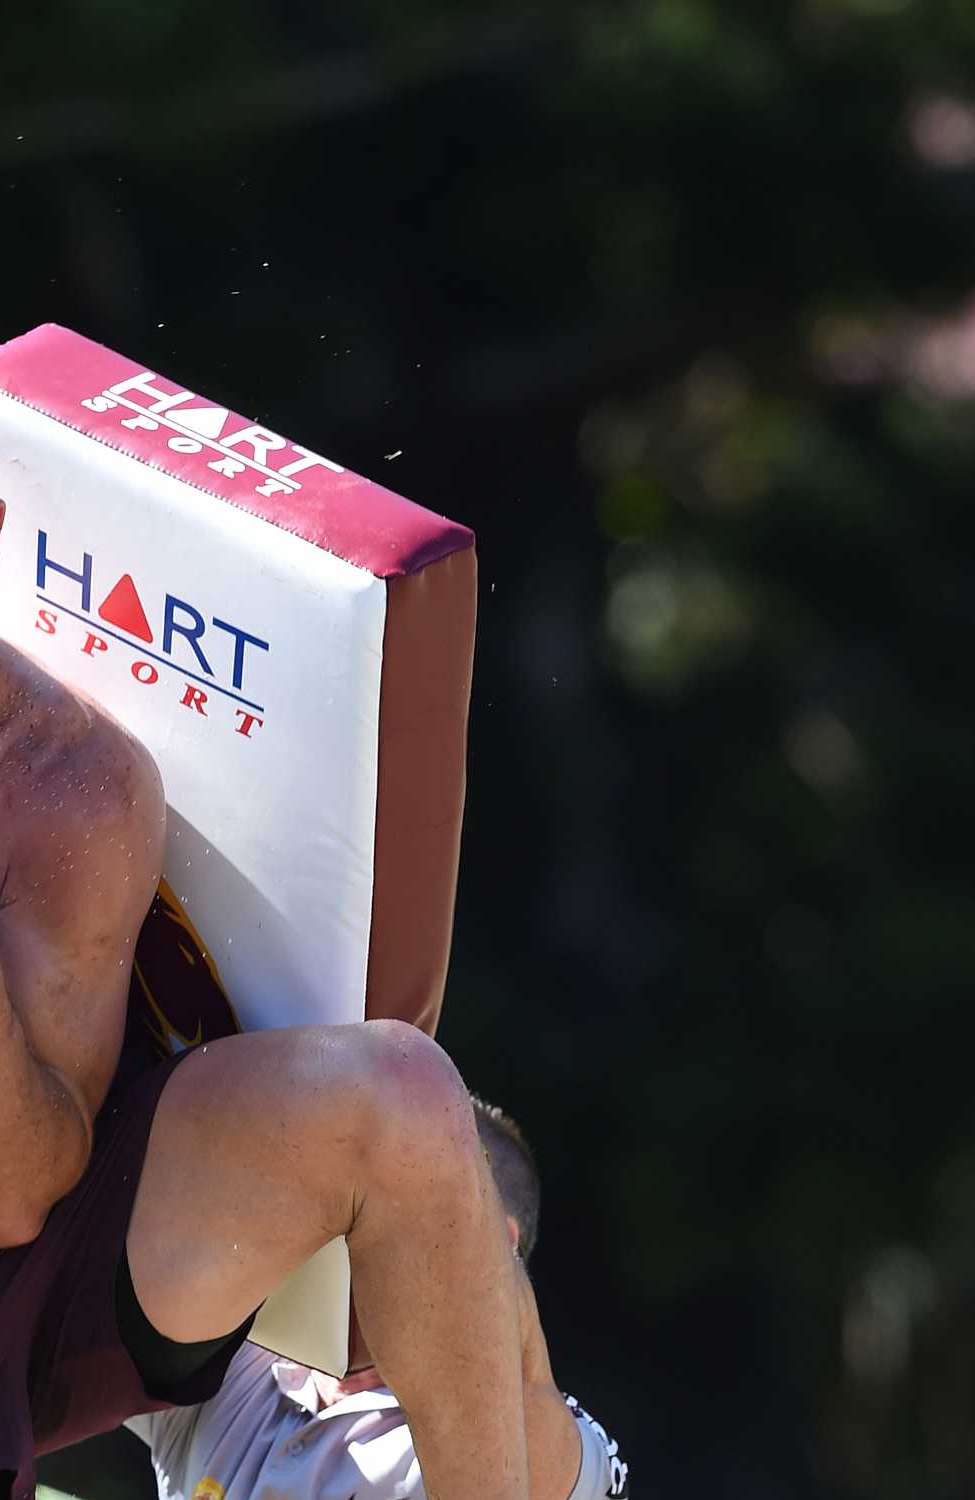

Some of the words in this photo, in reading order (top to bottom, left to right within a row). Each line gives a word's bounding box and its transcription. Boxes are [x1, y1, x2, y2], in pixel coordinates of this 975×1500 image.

[81, 392, 293, 499] SPORT
[106, 371, 345, 476] HART
[35, 529, 270, 691] HART
[34, 608, 264, 739] SPORT
